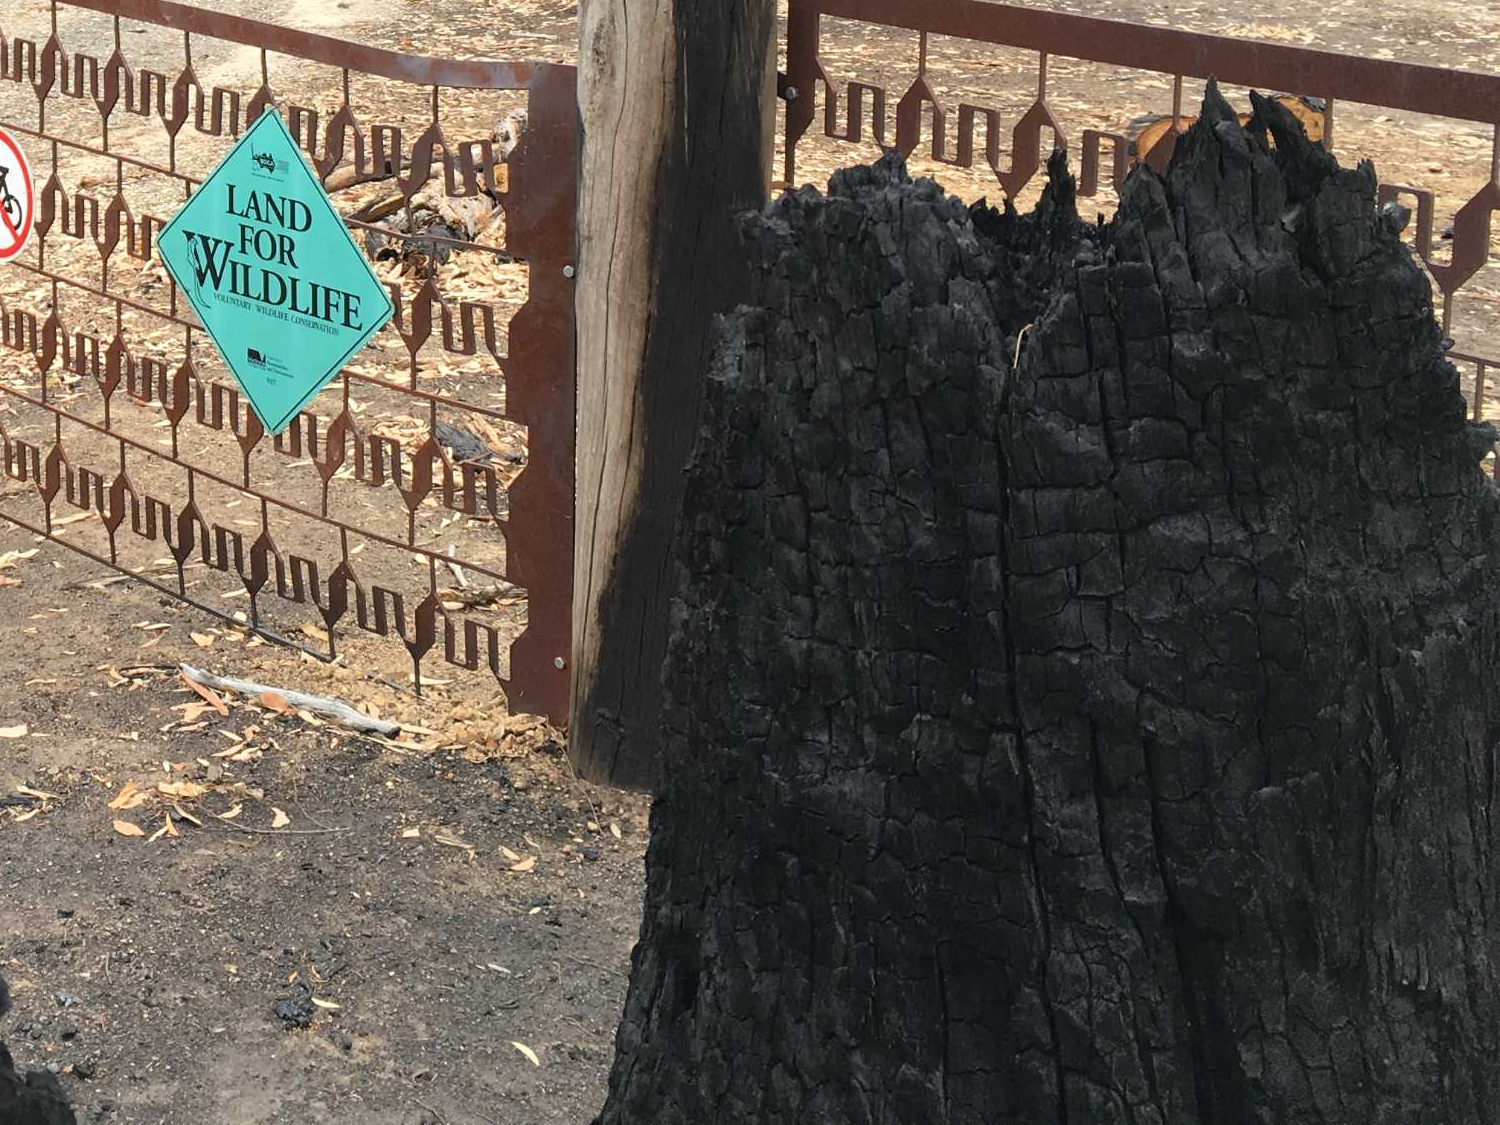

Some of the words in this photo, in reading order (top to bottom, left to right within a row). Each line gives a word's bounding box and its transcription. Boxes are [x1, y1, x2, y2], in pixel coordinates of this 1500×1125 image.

[226, 183, 313, 233] LAND
[238, 223, 299, 269] FOR
[182, 230, 363, 331] WILDLIFE
[214, 292, 252, 311] VOLUNTARY
[255, 304, 288, 321] WILDLIFE
[290, 314, 340, 337] CONSERVATION
